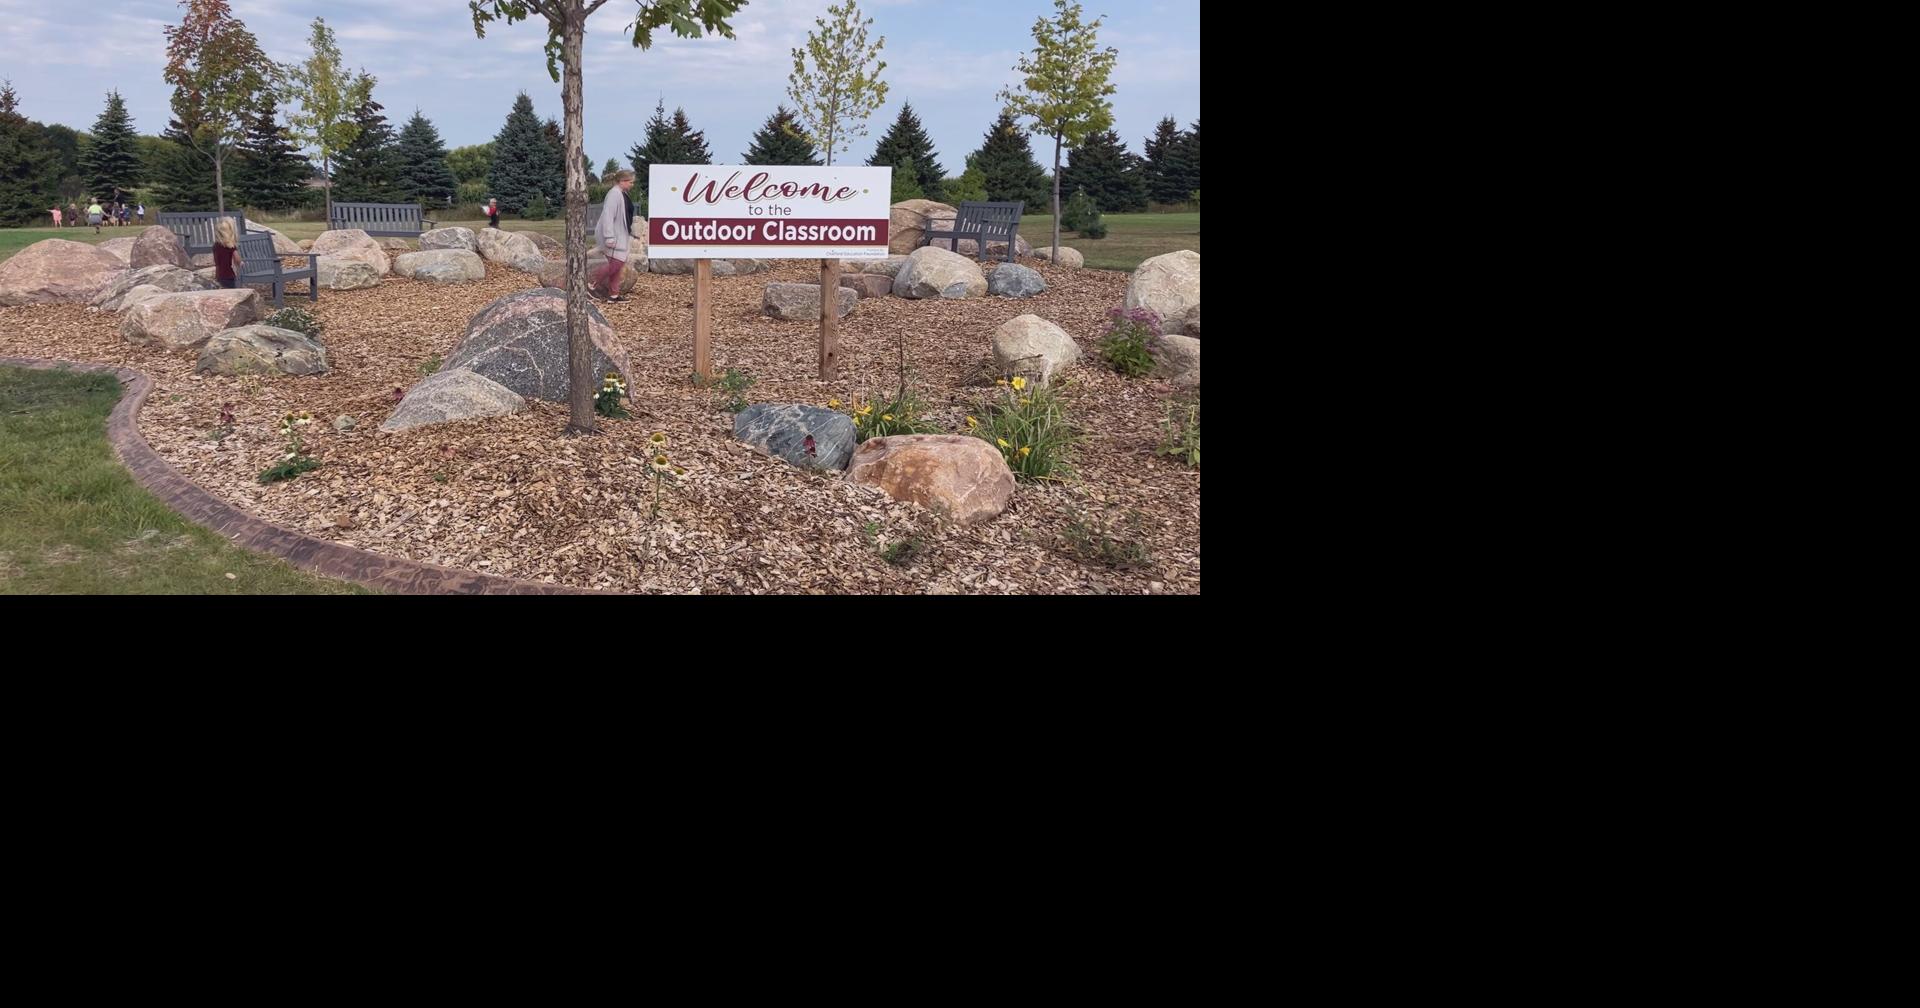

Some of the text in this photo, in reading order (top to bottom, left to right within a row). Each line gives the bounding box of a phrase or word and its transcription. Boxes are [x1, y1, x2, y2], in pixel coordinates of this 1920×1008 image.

[682, 170, 857, 204] Welcome
[749, 204, 792, 216] to the
[662, 220, 876, 241] Outdoor Classroom
